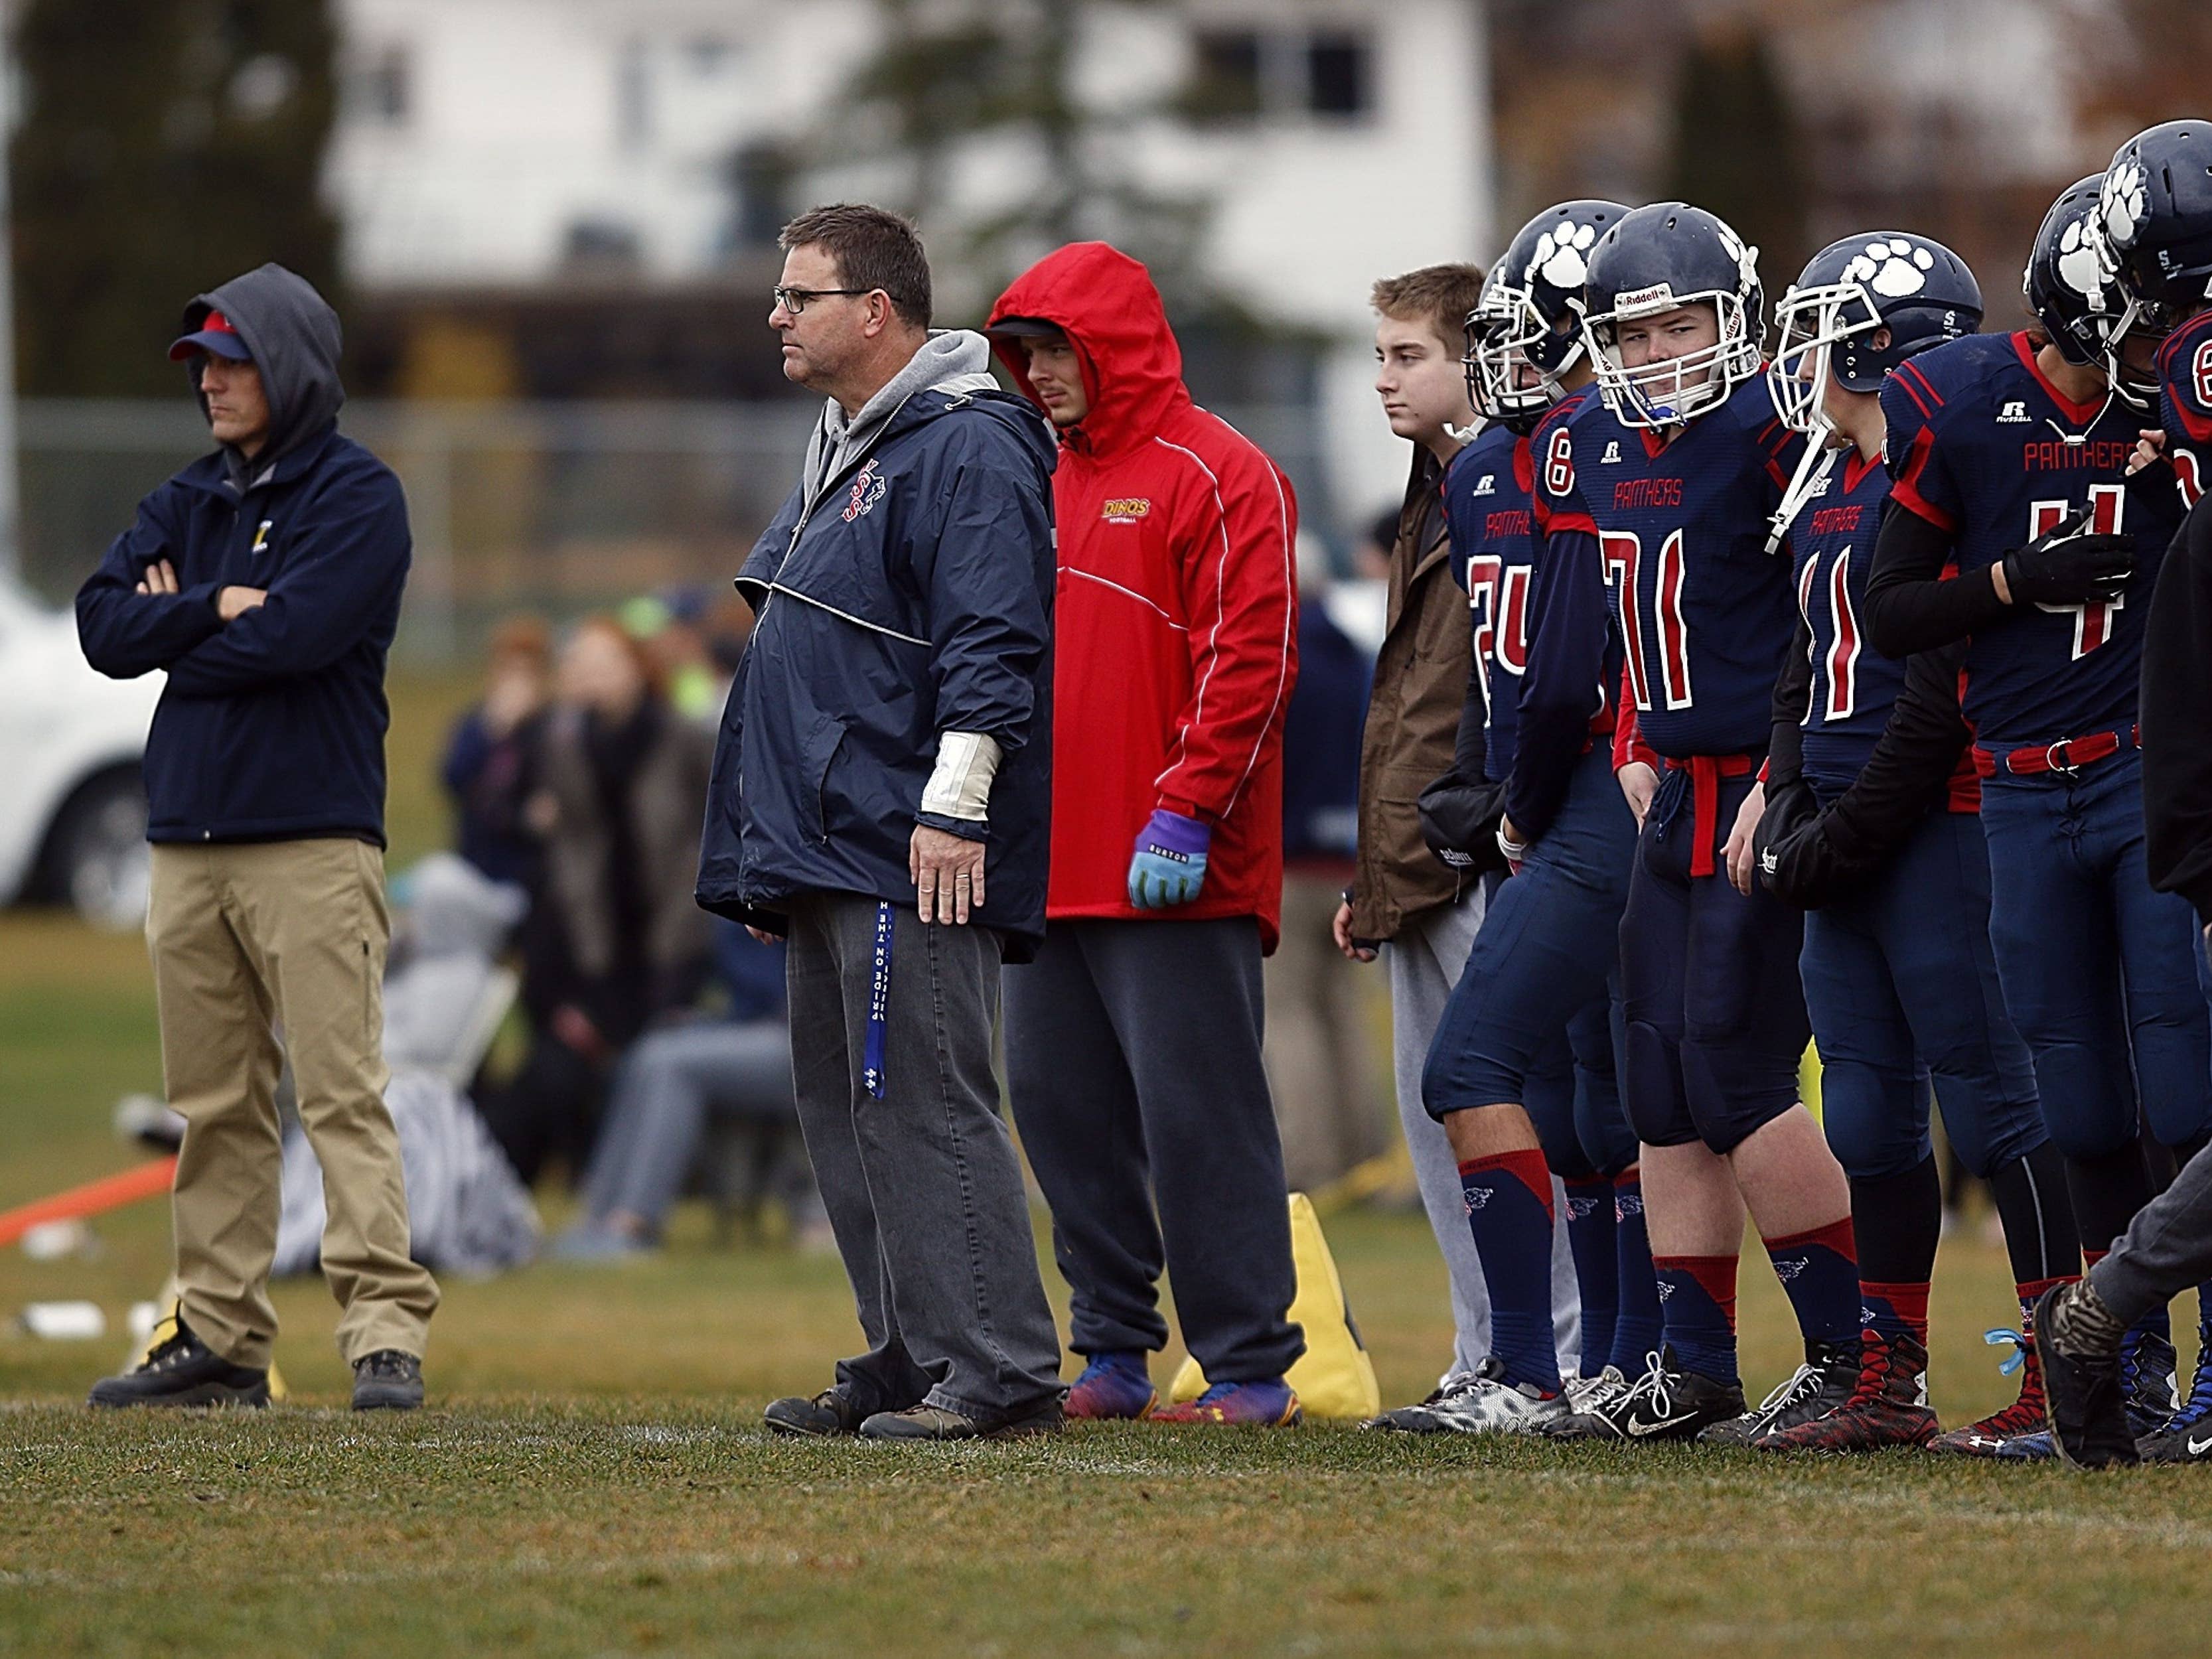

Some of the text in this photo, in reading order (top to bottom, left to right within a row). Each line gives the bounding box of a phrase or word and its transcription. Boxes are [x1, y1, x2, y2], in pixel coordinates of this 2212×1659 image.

[1626, 289, 1659, 305] Riddell
[1726, 312, 1741, 341] ddell
[1545, 427, 1575, 497] 8
[1102, 498, 1150, 518] DINOS
[1613, 478, 1684, 510] PANTHERS
[1599, 528, 1694, 711] 71
[1149, 843, 1187, 863] BURTON
[877, 913, 886, 943] THE
[875, 947, 885, 966] ON
[871, 972, 882, 1021] PRIDE
